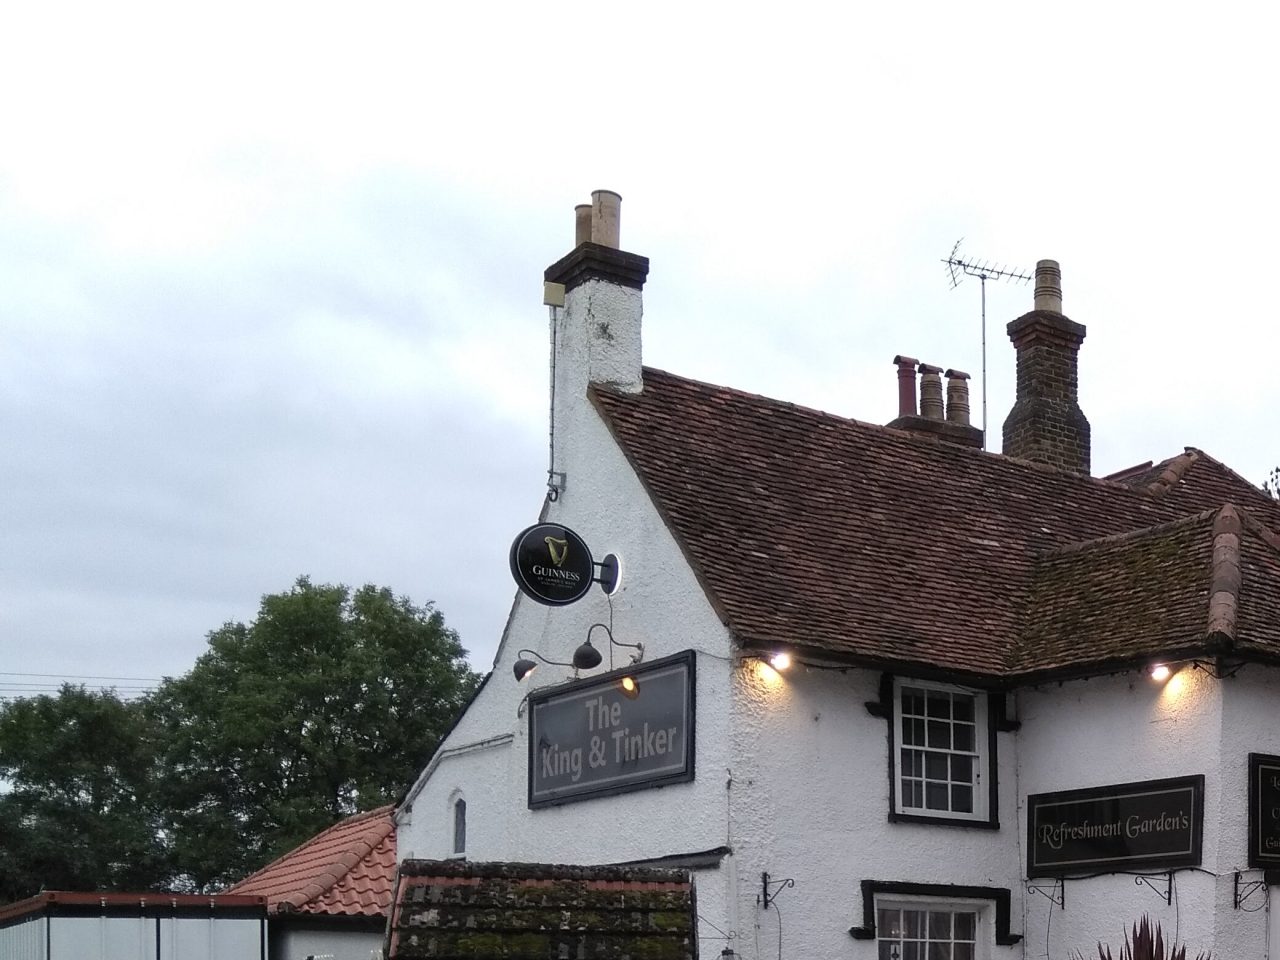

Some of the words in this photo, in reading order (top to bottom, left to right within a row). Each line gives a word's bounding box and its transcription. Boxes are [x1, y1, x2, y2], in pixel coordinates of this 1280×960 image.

[533, 565, 580, 581] GUINNESS
[585, 697, 621, 731] The
[542, 744, 582, 780] King
[589, 736, 606, 768] &
[612, 723, 677, 762] Tinker
[1039, 820, 1121, 849] Refreshment
[1126, 811, 1188, 838] Garden's
